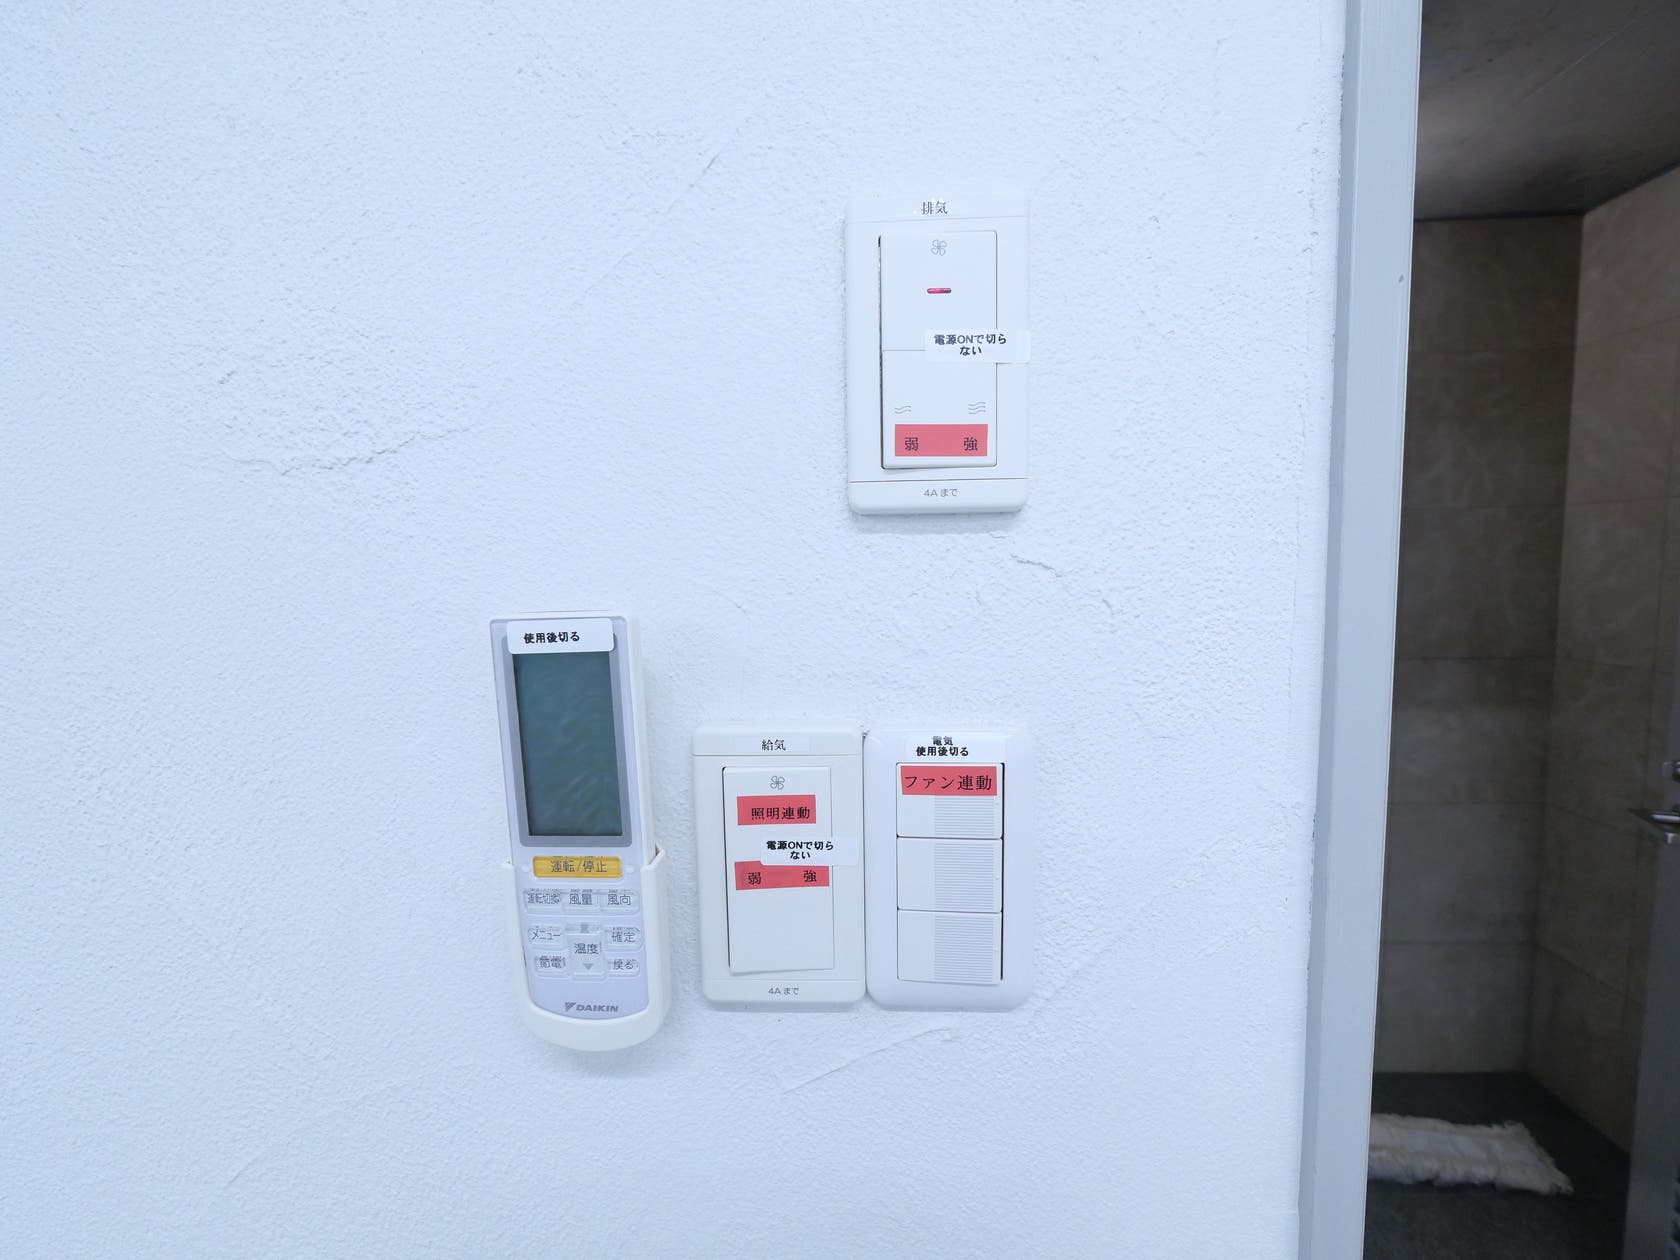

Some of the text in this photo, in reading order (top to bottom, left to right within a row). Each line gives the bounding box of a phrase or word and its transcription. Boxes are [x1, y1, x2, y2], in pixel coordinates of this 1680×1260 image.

[922, 201, 948, 215] 排気
[934, 333, 1007, 345] 電源ONで切ら
[960, 345, 982, 356] ない
[904, 437, 978, 451] 弱 強
[523, 631, 580, 644] 使用後切る
[761, 739, 787, 751] 給気
[932, 736, 954, 746] 電気
[915, 746, 969, 757] 使用後切る
[904, 775, 992, 791] ファン連動
[751, 806, 811, 820] 照明連動
[766, 840, 834, 851] 電源ONで切ら
[790, 851, 811, 860] ない
[551, 860, 608, 873] 運転/停止
[748, 869, 817, 885] 弱 強
[569, 893, 593, 905] 風量
[607, 893, 631, 905] 風向
[531, 928, 561, 941] メニュー
[612, 931, 636, 943] 確定
[574, 943, 599, 955] 温度
[613, 959, 634, 970] 戻る
[575, 1002, 619, 1013] DAIKIN
